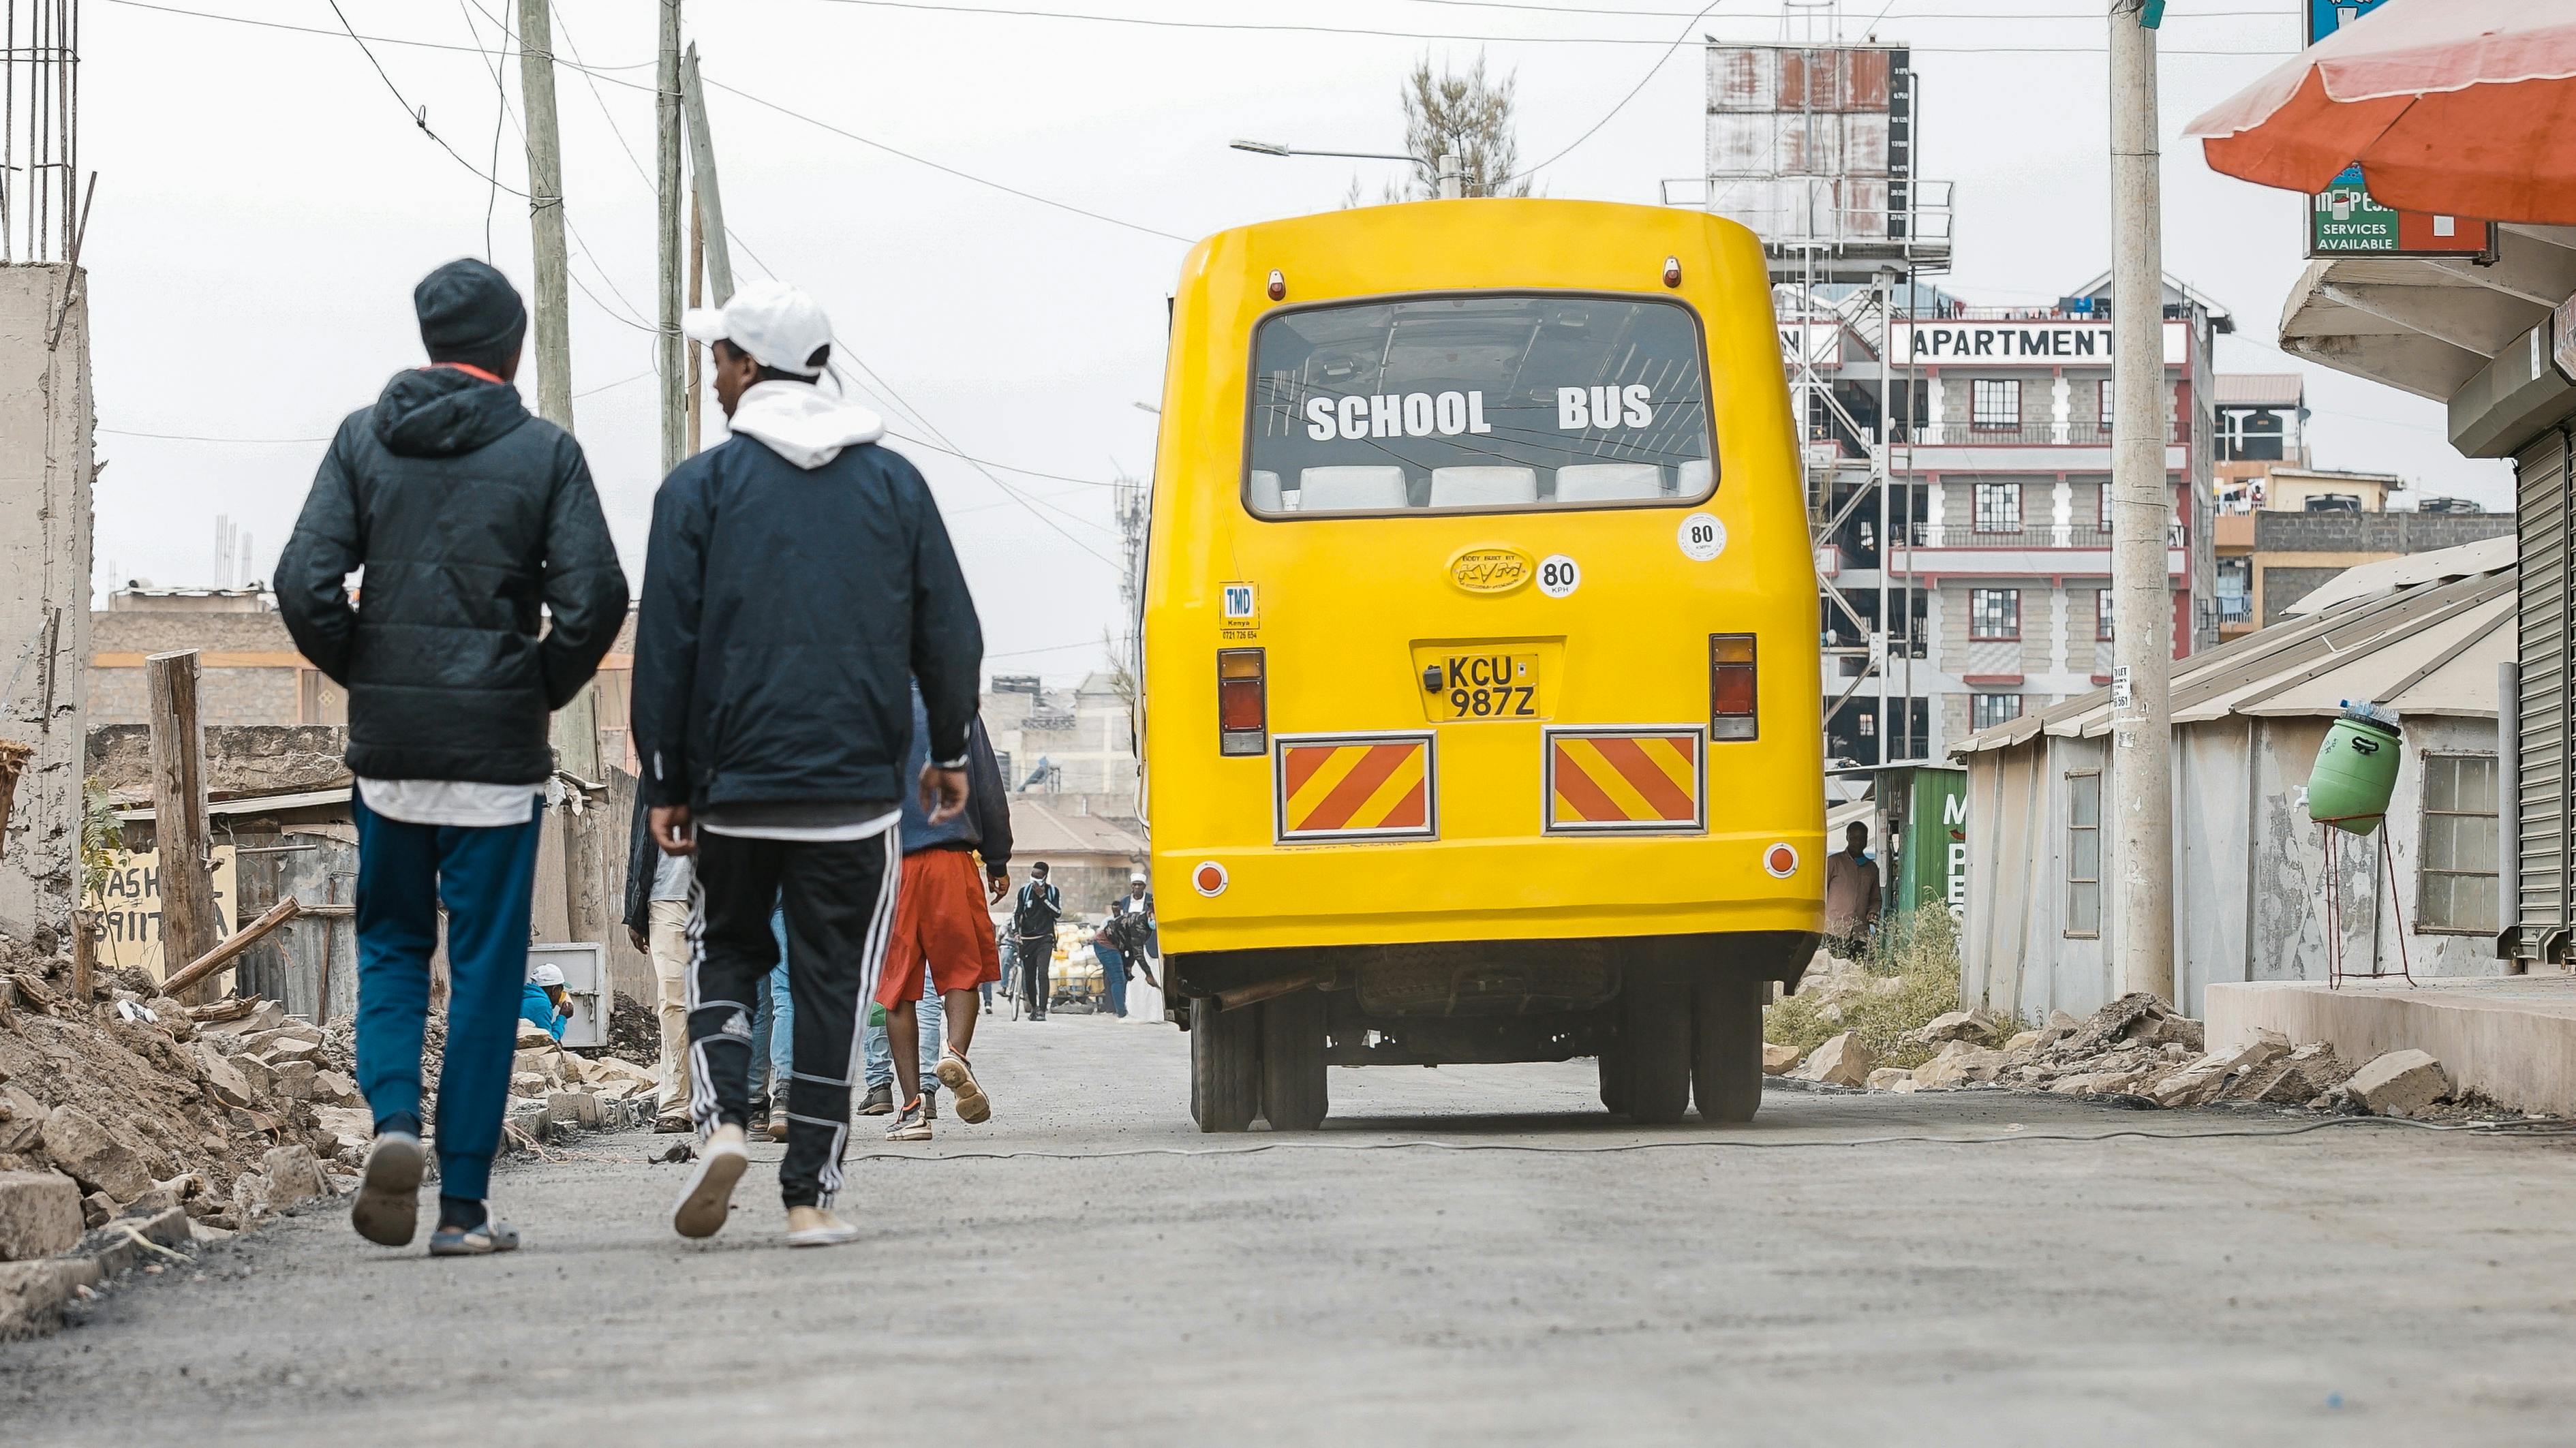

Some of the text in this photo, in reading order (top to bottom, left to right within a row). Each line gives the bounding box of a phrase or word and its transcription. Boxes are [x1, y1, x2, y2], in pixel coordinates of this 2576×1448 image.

[2322, 224, 2387, 235] SERVICES
[2317, 238, 2393, 249] AVAILABLE
[1306, 384, 1653, 442] SCHOOL BUS
[1691, 525, 1713, 544] 80
[1544, 563, 1574, 586] 80
[1227, 589, 1250, 615] TMD
[1449, 656, 1512, 688] KCU
[1451, 686, 1535, 717] 987Z
